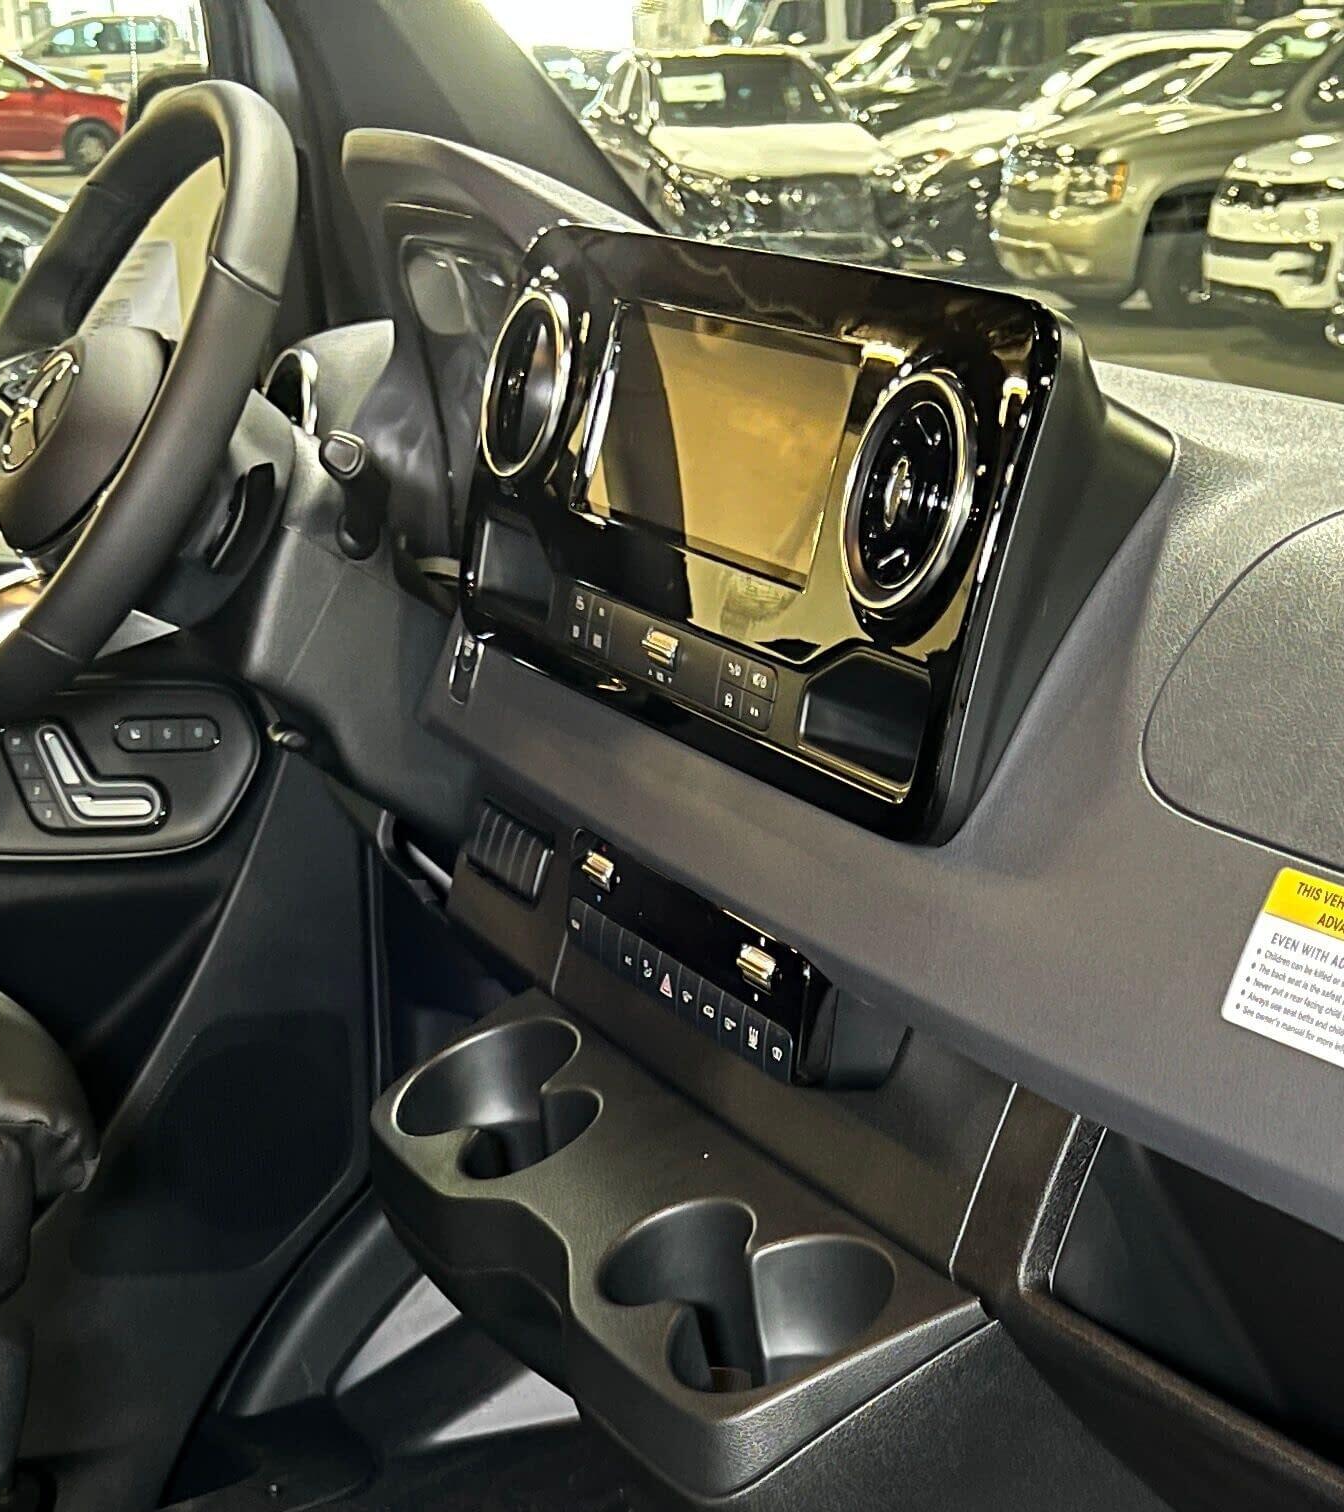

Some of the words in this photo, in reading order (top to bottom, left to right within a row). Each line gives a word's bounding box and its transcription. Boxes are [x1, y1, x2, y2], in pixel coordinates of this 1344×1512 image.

[1296, 882, 1323, 900] THIS
[1270, 932, 1300, 952] EVEN
[1301, 943, 1330, 964] WITH
